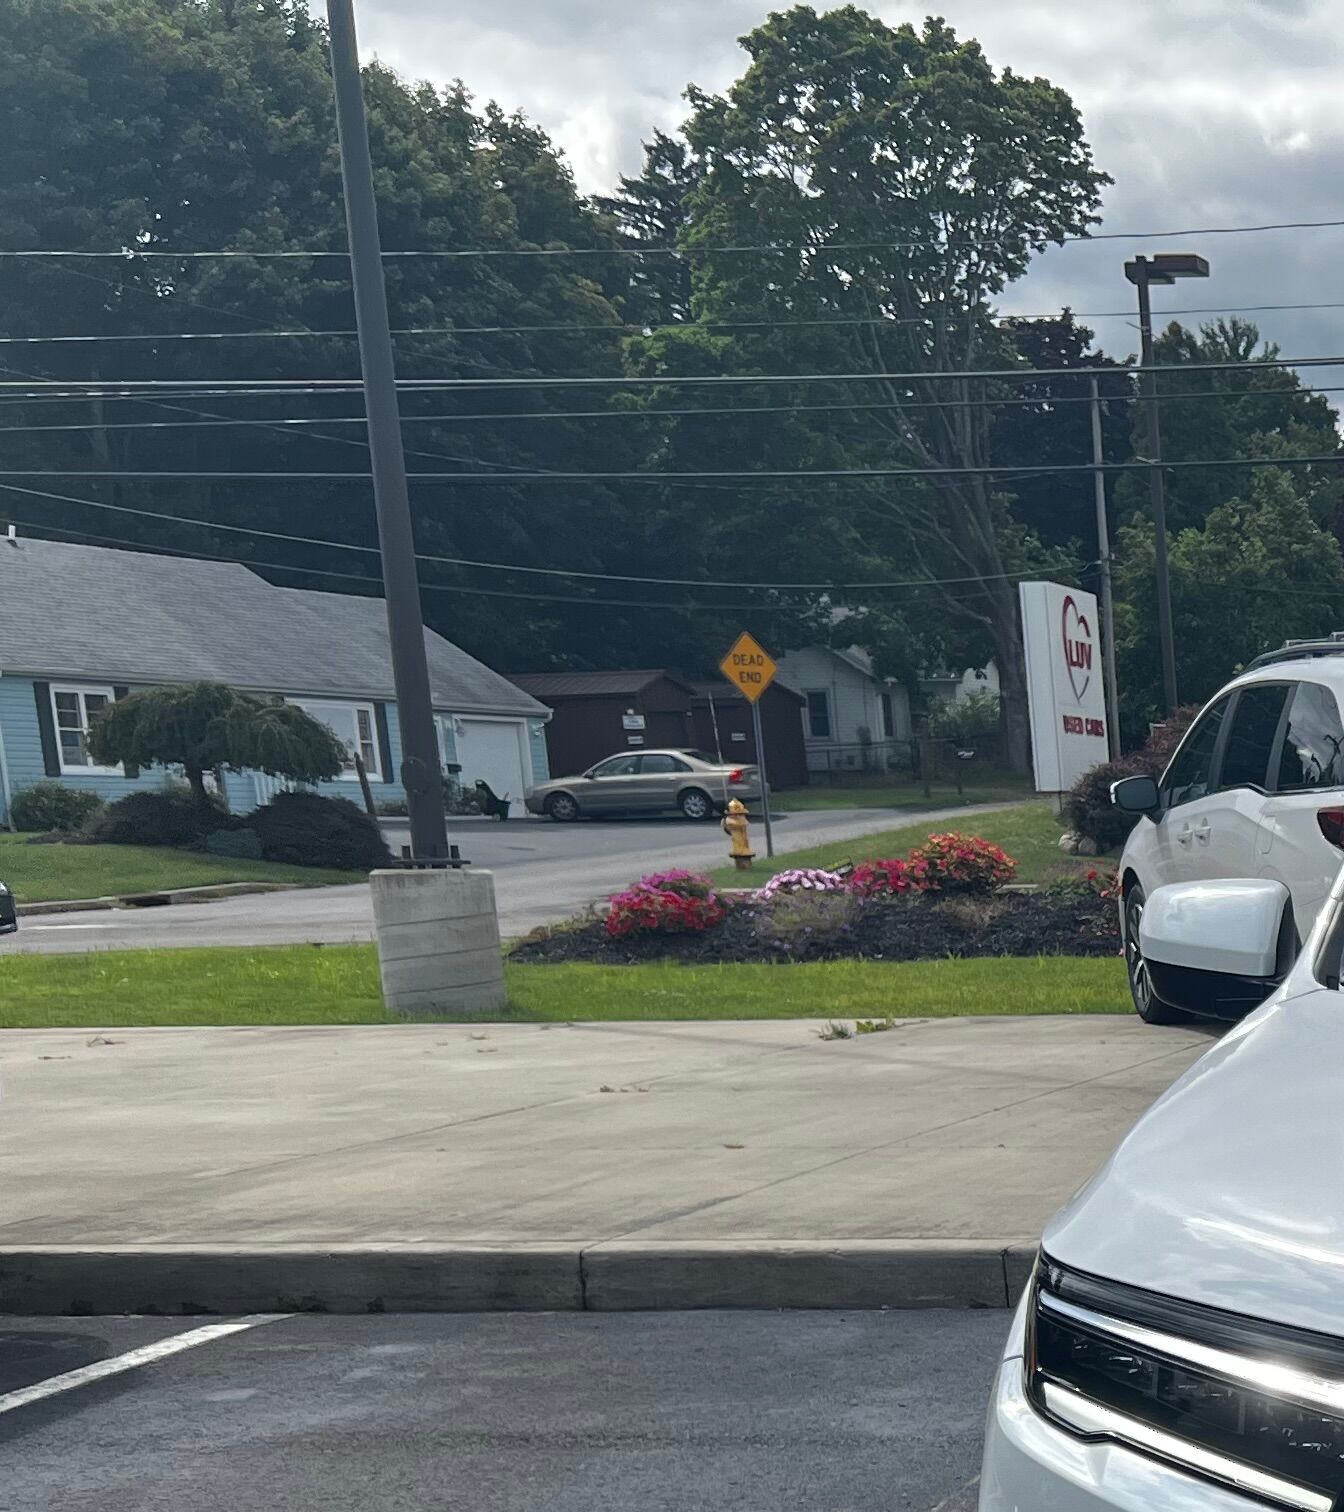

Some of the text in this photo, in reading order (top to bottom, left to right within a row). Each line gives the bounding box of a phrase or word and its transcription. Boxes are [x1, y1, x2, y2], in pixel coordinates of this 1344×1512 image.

[733, 654, 764, 666] DEAD
[1068, 639, 1092, 670] LUV
[739, 671, 762, 683] END
[1063, 715, 1104, 737] USED CARS
